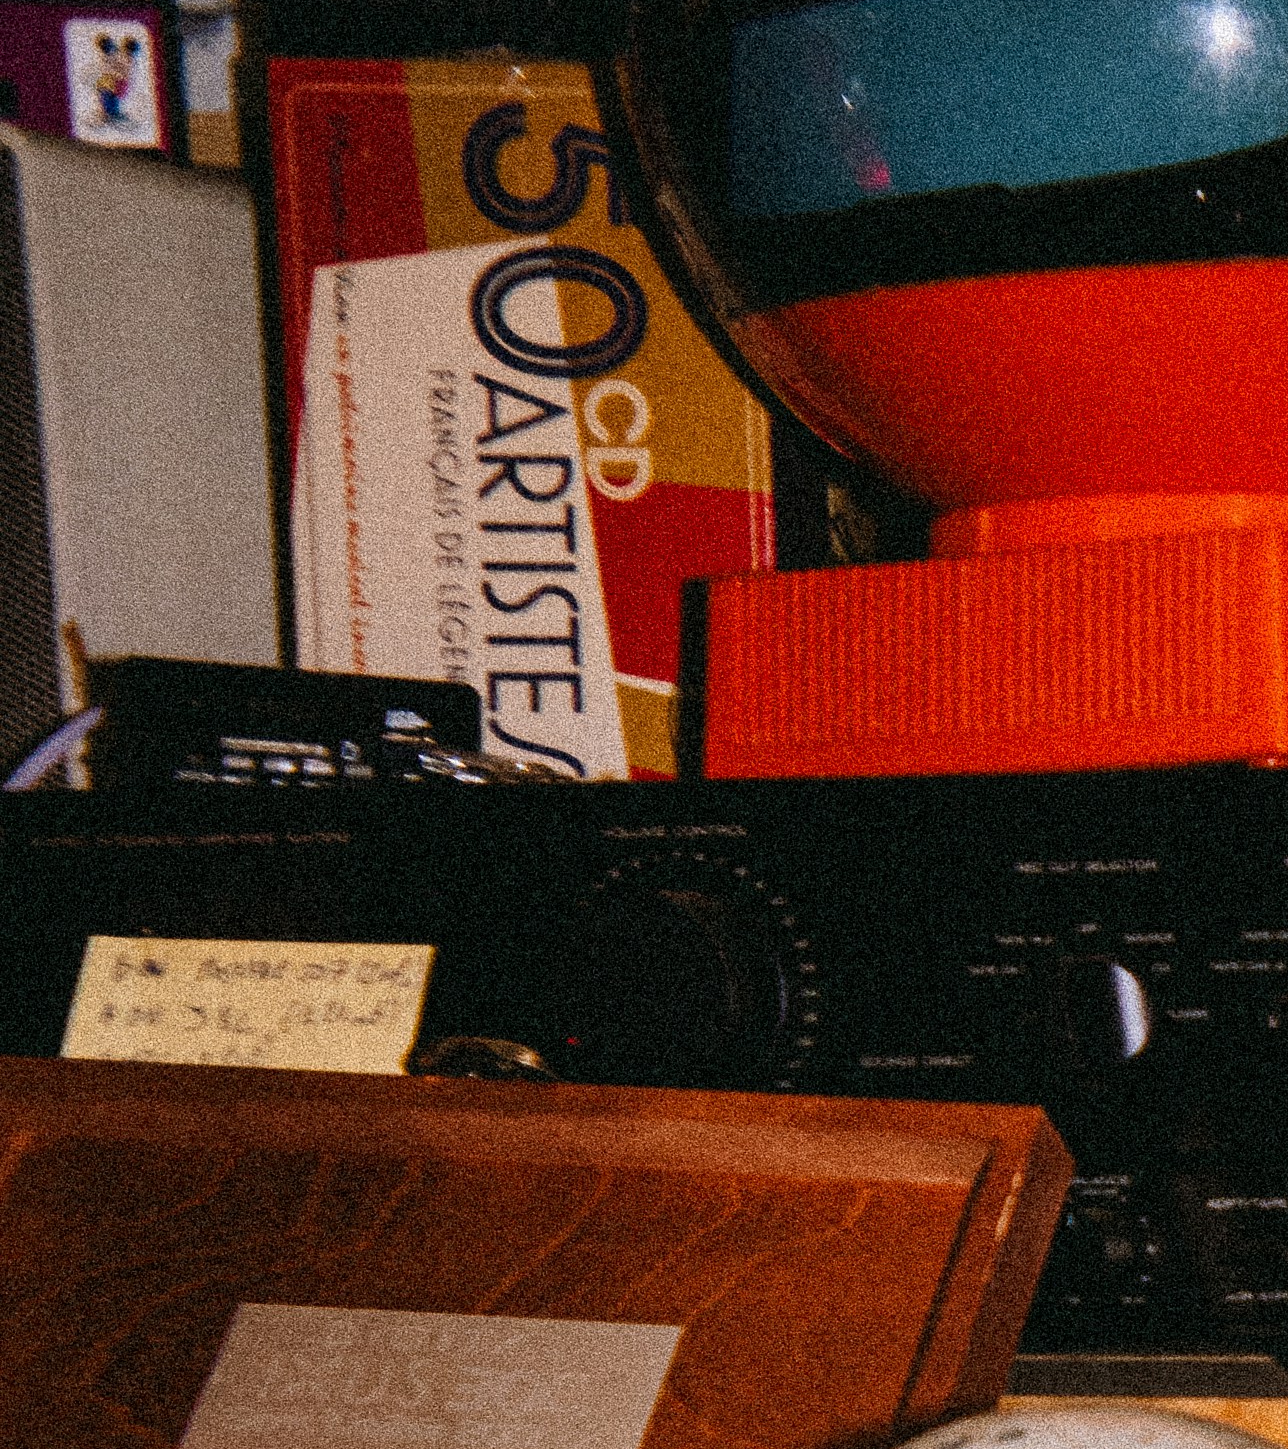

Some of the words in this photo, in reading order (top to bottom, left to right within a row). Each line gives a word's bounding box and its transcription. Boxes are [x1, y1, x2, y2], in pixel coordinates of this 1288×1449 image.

[464, 103, 648, 377] 50
[430, 370, 463, 518] FRANÇAIS
[586, 380, 651, 500] CD
[437, 534, 466, 569] DE
[474, 374, 586, 779] ARTISTES
